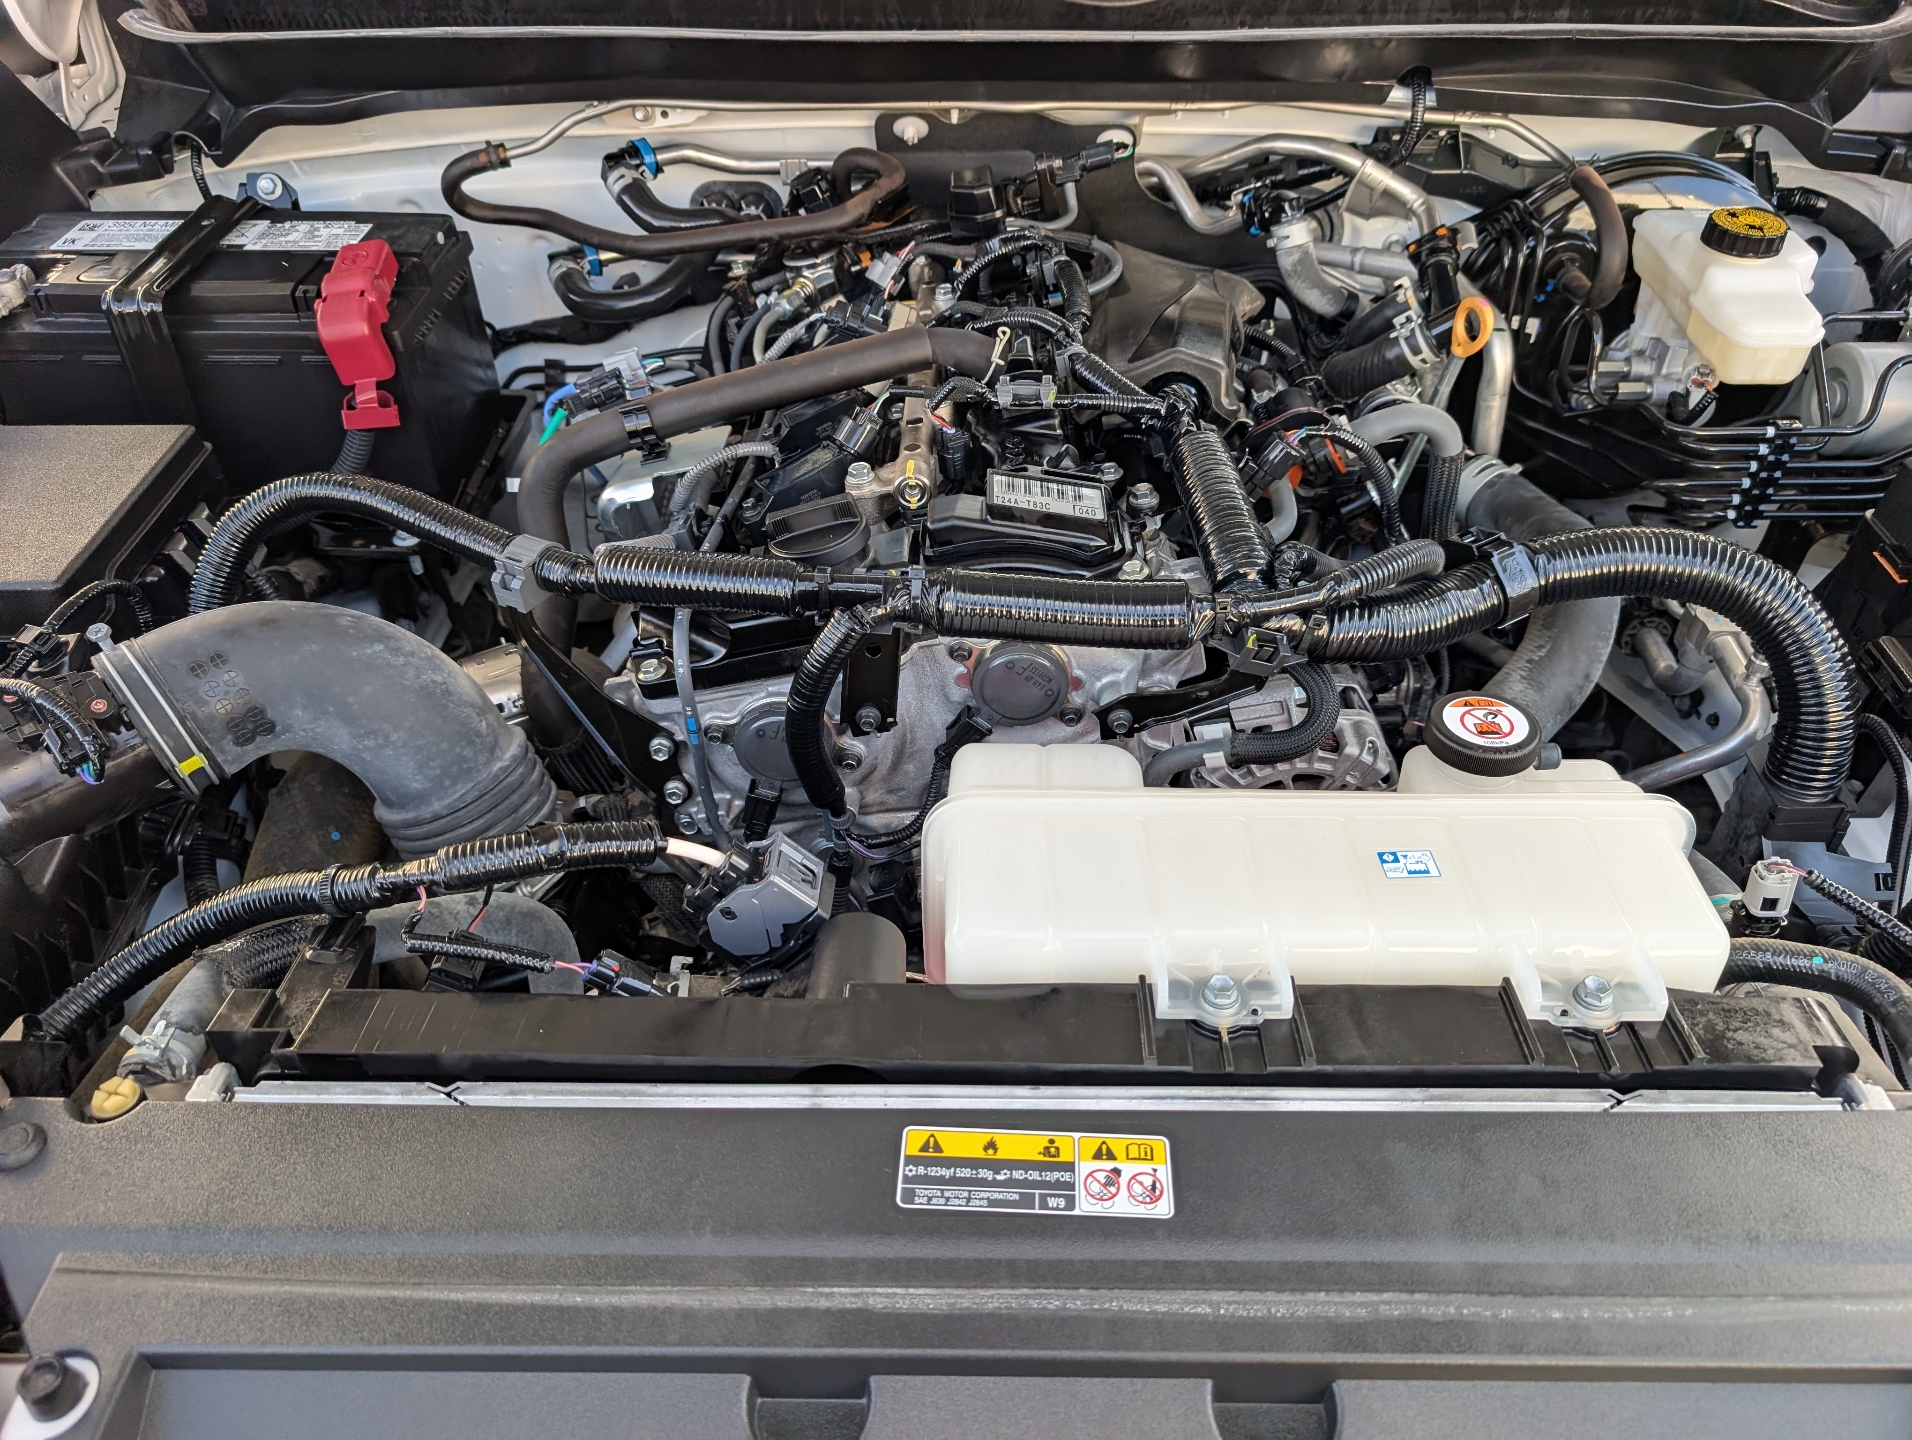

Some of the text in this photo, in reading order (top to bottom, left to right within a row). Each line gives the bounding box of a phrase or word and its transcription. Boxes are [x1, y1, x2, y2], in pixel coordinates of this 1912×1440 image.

[62, 237, 79, 245] VK
[995, 495, 1051, 511] T24A-T83C
[1078, 507, 1097, 517] 040
[1864, 969, 1899, 1002] 02/04/24
[917, 1165, 1074, 1184] R-1234yf 520±30g ND-OIL12(POE)
[914, 1196, 928, 1204] SAE
[915, 1189, 1019, 1200] TOYOTA MOTOR CORPORATION
[1047, 1197, 1065, 1208] W9
